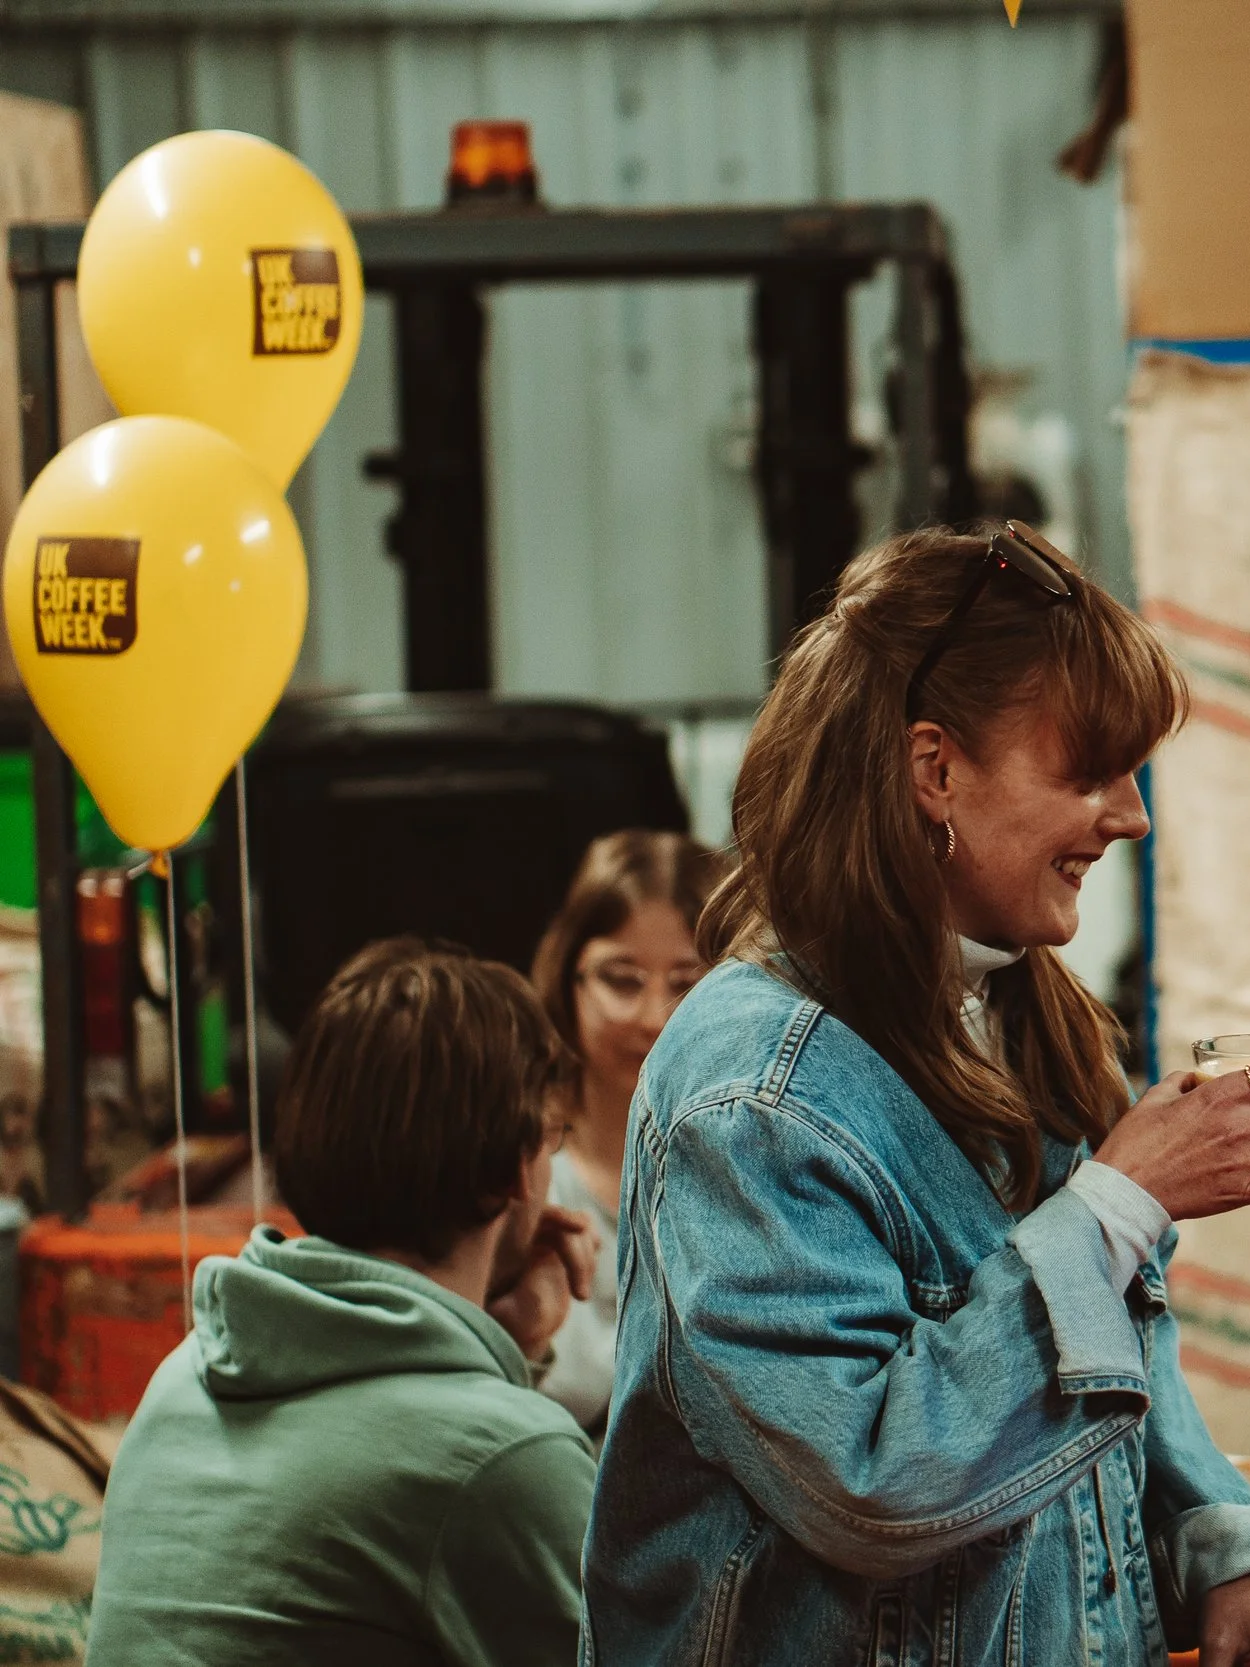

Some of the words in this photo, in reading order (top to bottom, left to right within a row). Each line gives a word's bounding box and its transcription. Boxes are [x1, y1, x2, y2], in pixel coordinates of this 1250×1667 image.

[258, 255, 295, 284] UK
[261, 284, 337, 318] COFFEE
[40, 542, 71, 578] UK
[39, 577, 127, 615] COFFEE
[40, 611, 109, 650] WEEK
